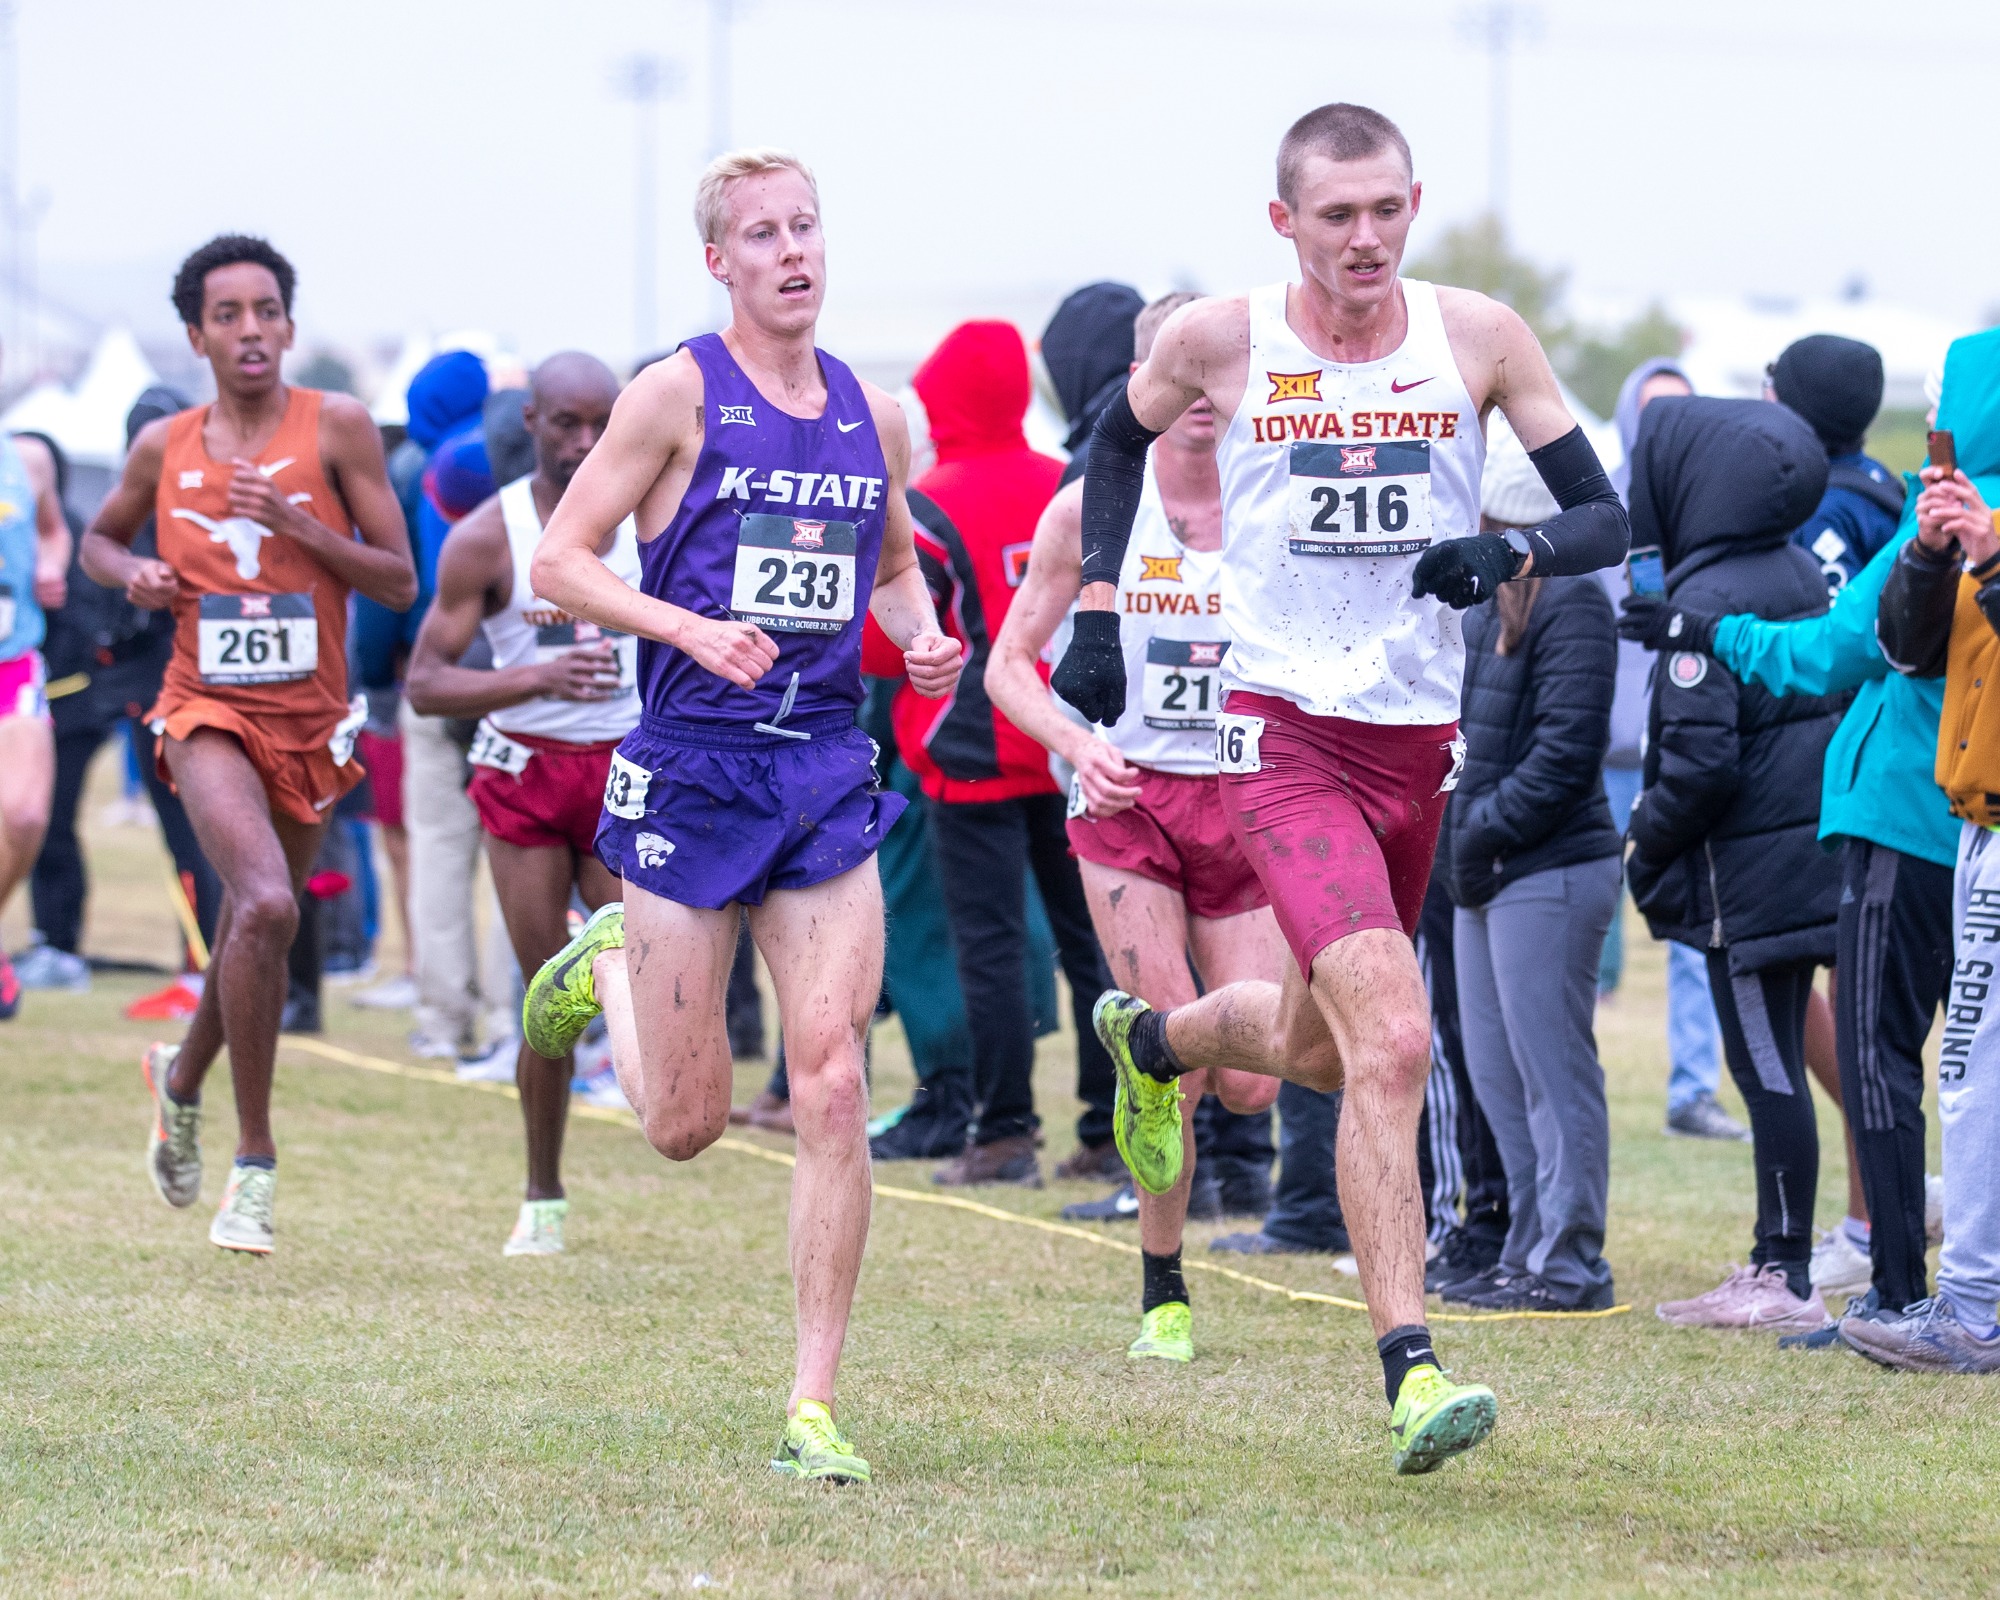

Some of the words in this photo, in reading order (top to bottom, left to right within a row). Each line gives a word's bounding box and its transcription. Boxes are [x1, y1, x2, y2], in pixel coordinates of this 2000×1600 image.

[1252, 413, 1345, 443] IOWA
[1351, 411, 1460, 439] STATE
[715, 467, 883, 511] K-STATE
[1310, 484, 1409, 533] 216
[1300, 543, 1336, 554] LUBBOCK,
[1336, 546, 1346, 554] TX
[1353, 543, 1387, 554] OCTOBER
[1389, 543, 1401, 552] 28,
[1402, 542, 1420, 552] 2022
[754, 557, 840, 610] 233
[1125, 592, 1200, 615] IOWA
[741, 614, 777, 627] LUBBOCK,
[778, 618, 788, 627] TX
[795, 620, 819, 630] OCTOBER
[219, 628, 290, 664] 261
[1939, 958, 1994, 1083] SPRING
